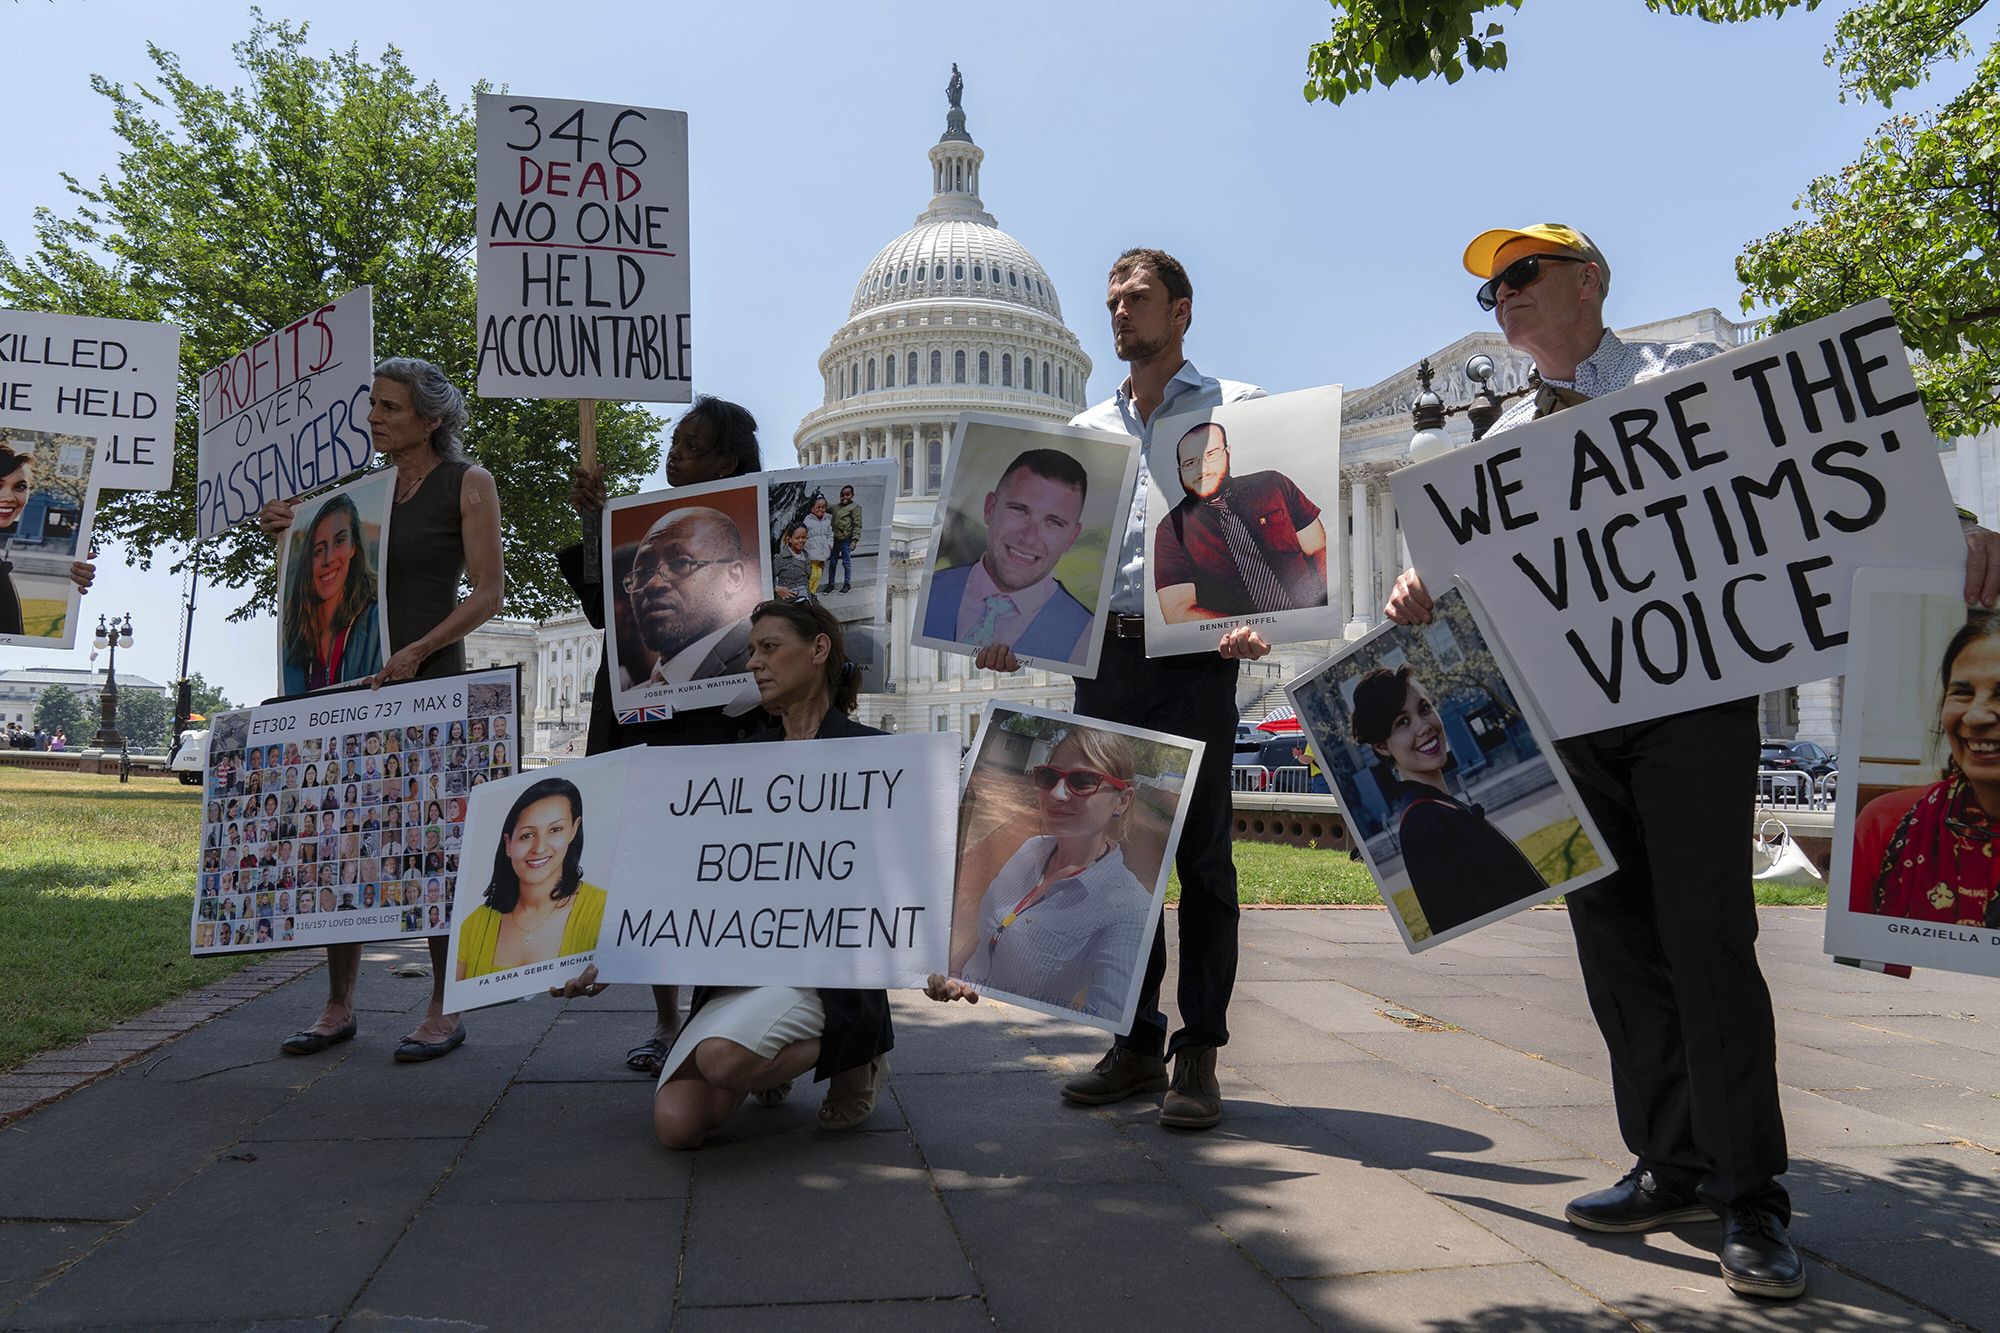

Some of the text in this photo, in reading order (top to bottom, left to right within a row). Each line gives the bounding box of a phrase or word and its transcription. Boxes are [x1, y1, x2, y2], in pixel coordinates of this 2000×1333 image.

[506, 104, 647, 168] 346
[519, 155, 642, 203] DEAD
[490, 199, 670, 250] NO ONE
[522, 252, 646, 311] HELD
[477, 313, 692, 382] ACCOUNTABLE
[56, 386, 158, 420] HELD
[235, 377, 313, 447] OVER
[1423, 315, 1920, 546] WE ARE THE
[198, 384, 371, 539] PASSENGERS
[1512, 429, 1900, 612] VICTIMS'
[1199, 616, 1278, 632] BENNETT RIFFEL
[1565, 554, 1849, 704] VOICE
[643, 677, 748, 699] JOSEPH KURIA WAITHAKA
[252, 692, 462, 735] ET302 BOEING 737 MAX 8
[669, 768, 904, 817] JAIL GUILTY
[696, 840, 856, 883] BOEING
[295, 914, 400, 931] 116/157 LOVED ONES LOST
[616, 906, 926, 949] MANAGEMENT
[1887, 923, 1979, 944] GRAZIELLA
[478, 954, 594, 987] FA SARA GEBRE MICHAE
